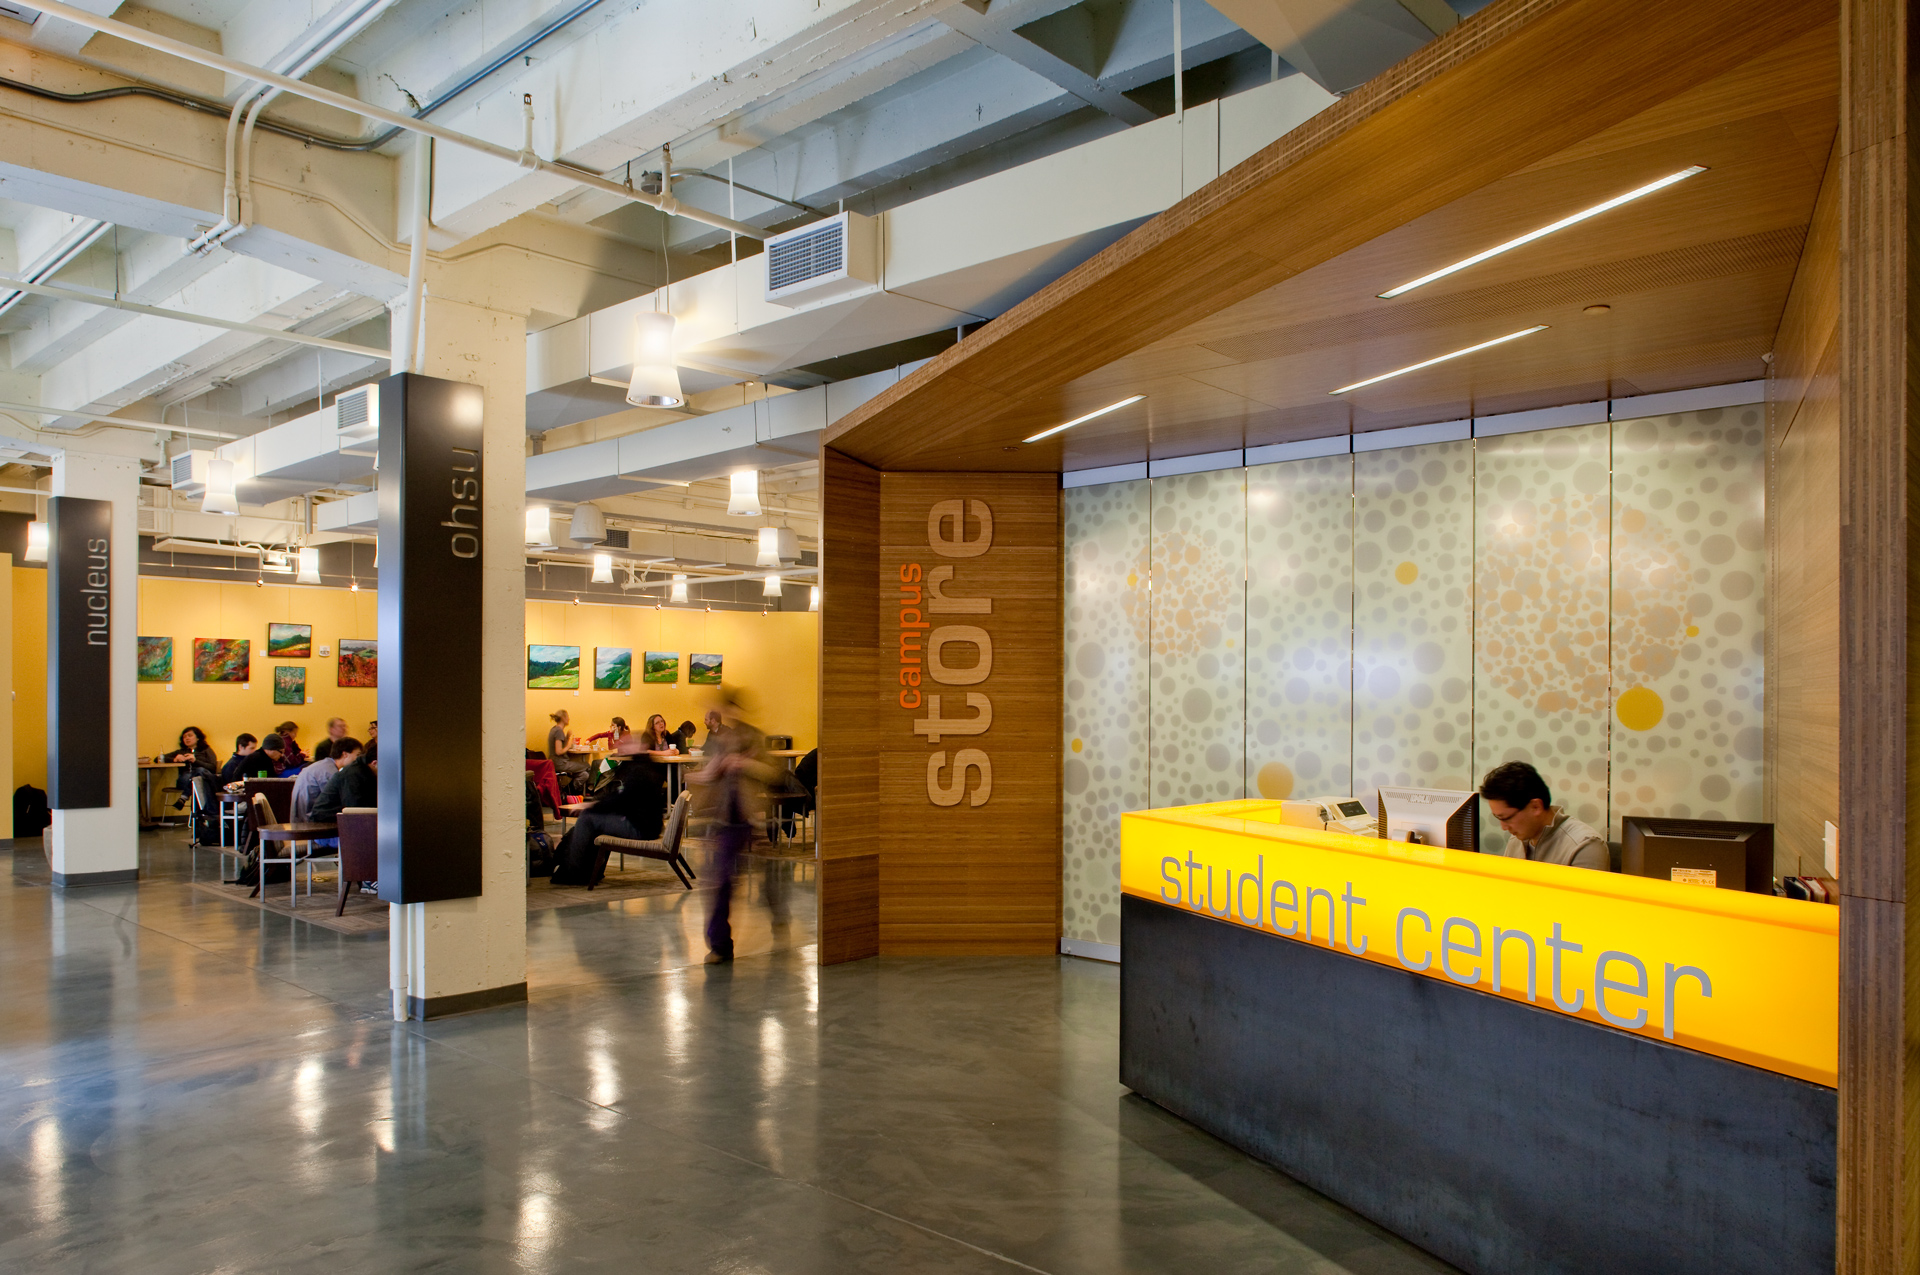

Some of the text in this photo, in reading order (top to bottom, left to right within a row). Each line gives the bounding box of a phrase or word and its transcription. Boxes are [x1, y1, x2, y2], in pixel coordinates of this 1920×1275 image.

[441, 446, 479, 558] ohsu
[79, 538, 108, 645] nucleus
[899, 563, 930, 709] campus
[914, 498, 994, 807] store
[1160, 850, 1713, 1040] student center
